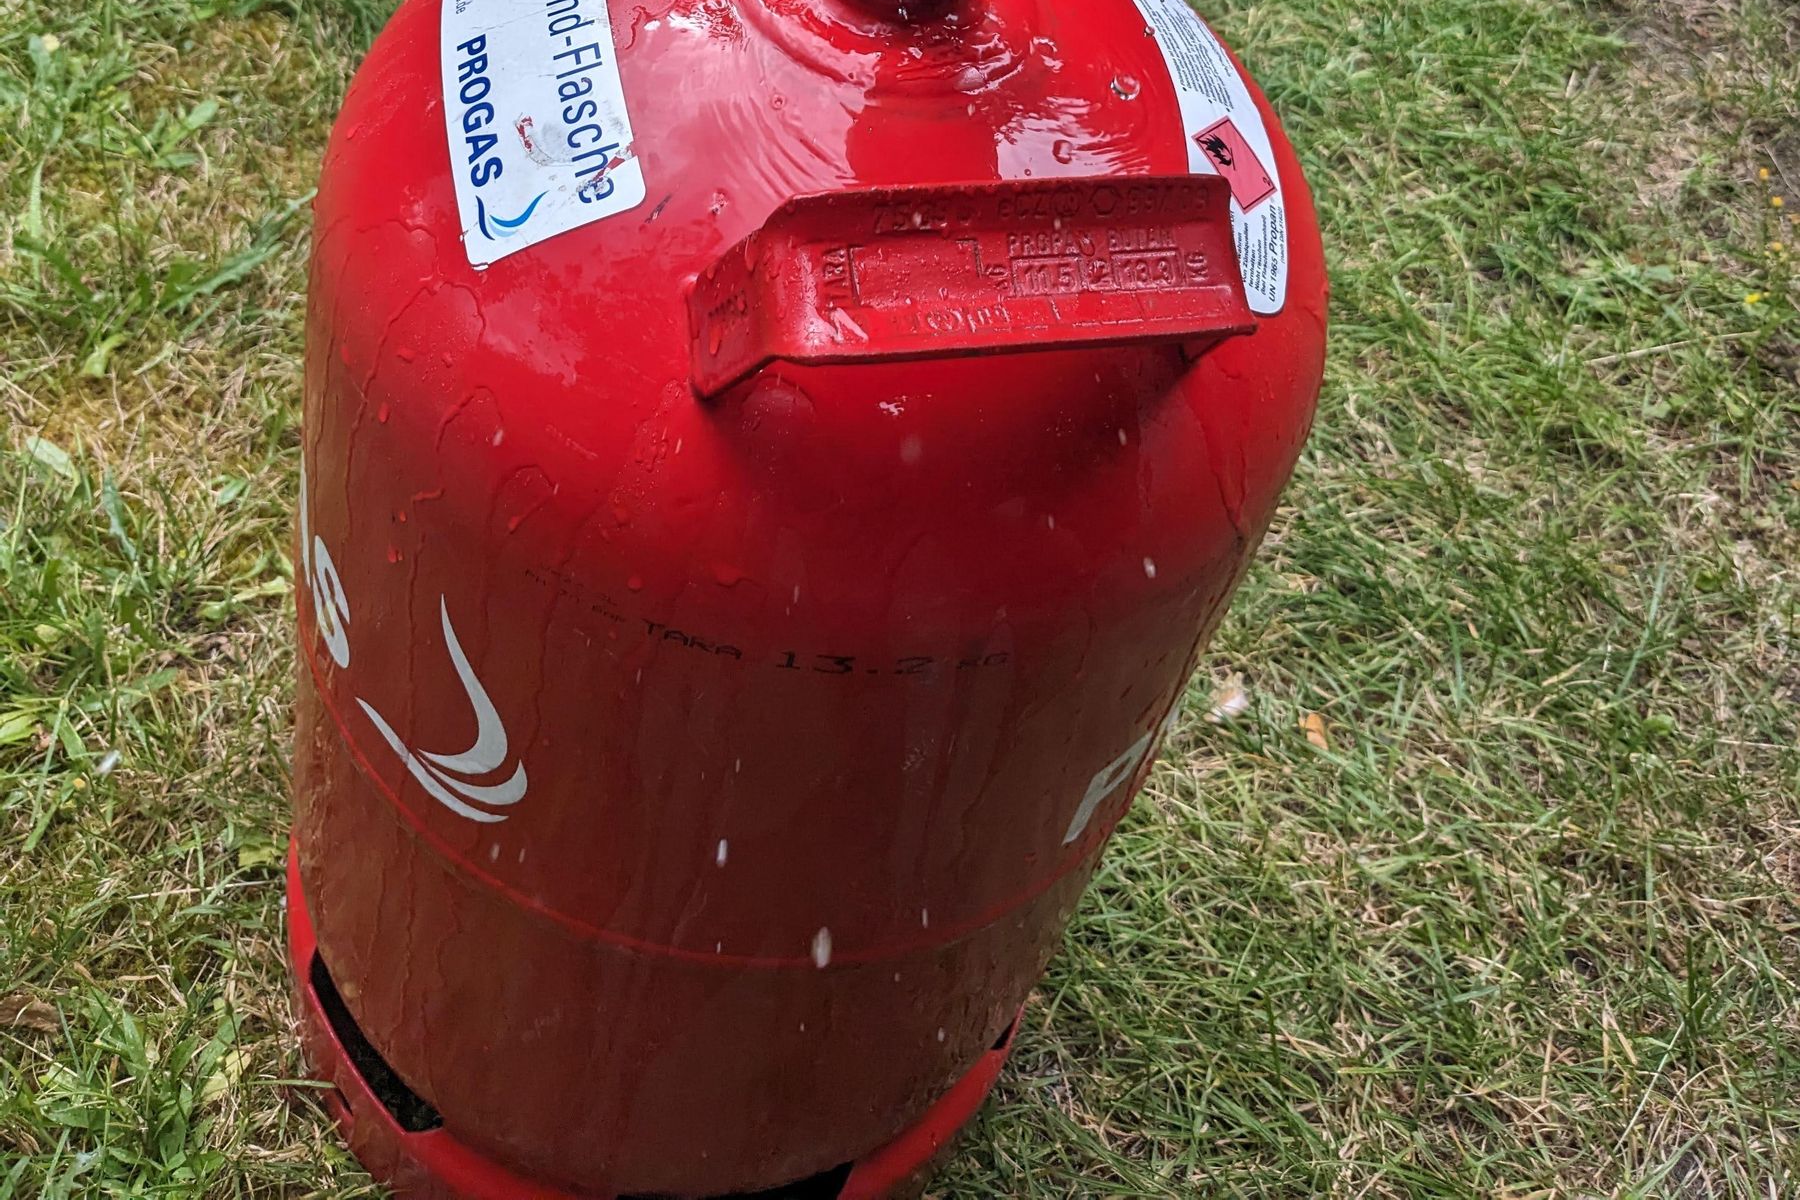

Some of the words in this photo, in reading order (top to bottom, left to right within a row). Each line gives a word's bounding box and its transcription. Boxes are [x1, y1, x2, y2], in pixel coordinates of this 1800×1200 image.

[456, 33, 504, 189] PROGAS
[1268, 204, 1279, 256] Propan
[1007, 232, 1095, 256] PROPA
[1269, 257, 1279, 282] 1965
[1268, 284, 1277, 303] UN
